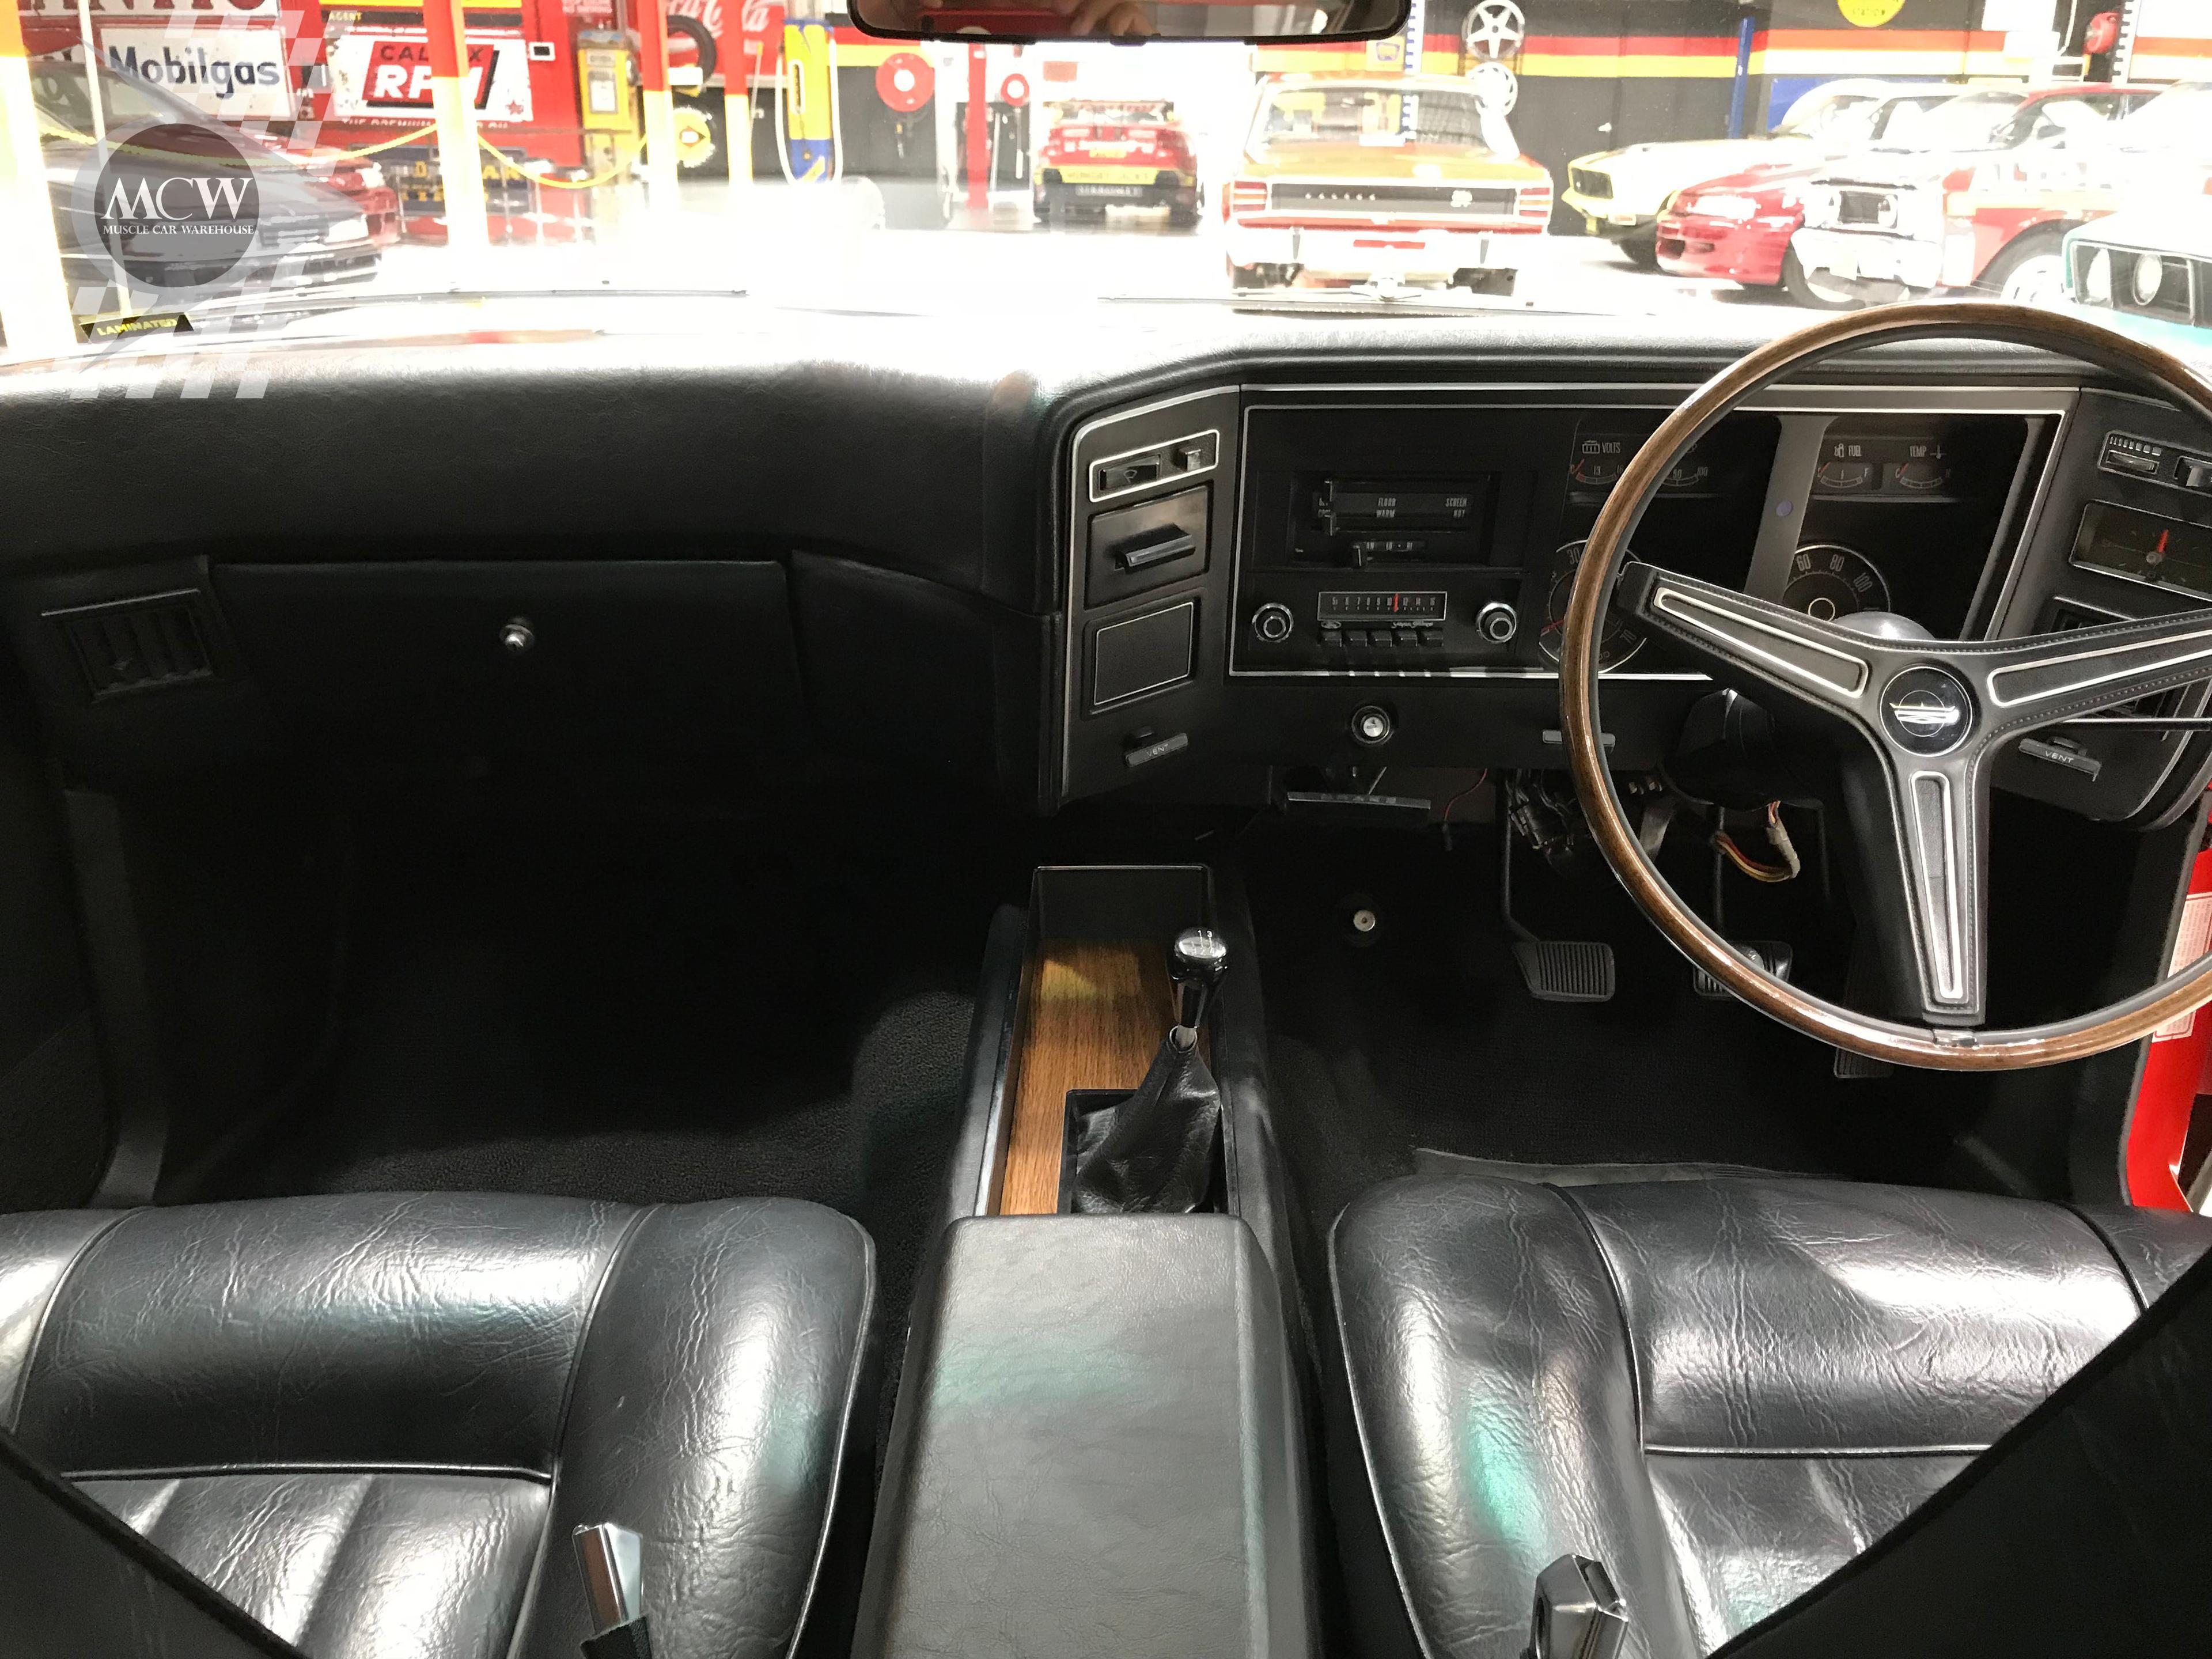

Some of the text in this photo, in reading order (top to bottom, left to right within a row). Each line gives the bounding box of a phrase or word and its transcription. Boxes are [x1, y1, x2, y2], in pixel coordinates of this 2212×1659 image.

[380, 45, 484, 63] CALX
[109, 46, 280, 99] Mobilgas
[97, 319, 177, 336] LAMINATED
[1601, 442, 1621, 454] VOLTS
[1848, 445, 1862, 457] FUEL
[1910, 445, 1927, 457] TEMP
[1378, 497, 1396, 507] FLOOR
[1445, 497, 1467, 507] SCREEN
[1376, 509, 1396, 518] WARM
[1567, 547, 1581, 565] 30
[1796, 554, 1812, 571] 60
[1830, 554, 1845, 572] 80
[1853, 572, 1873, 593] 100
[1619, 629, 1637, 645] 70
[1146, 743, 1169, 758] VENT
[2044, 751, 2074, 763] VENT
